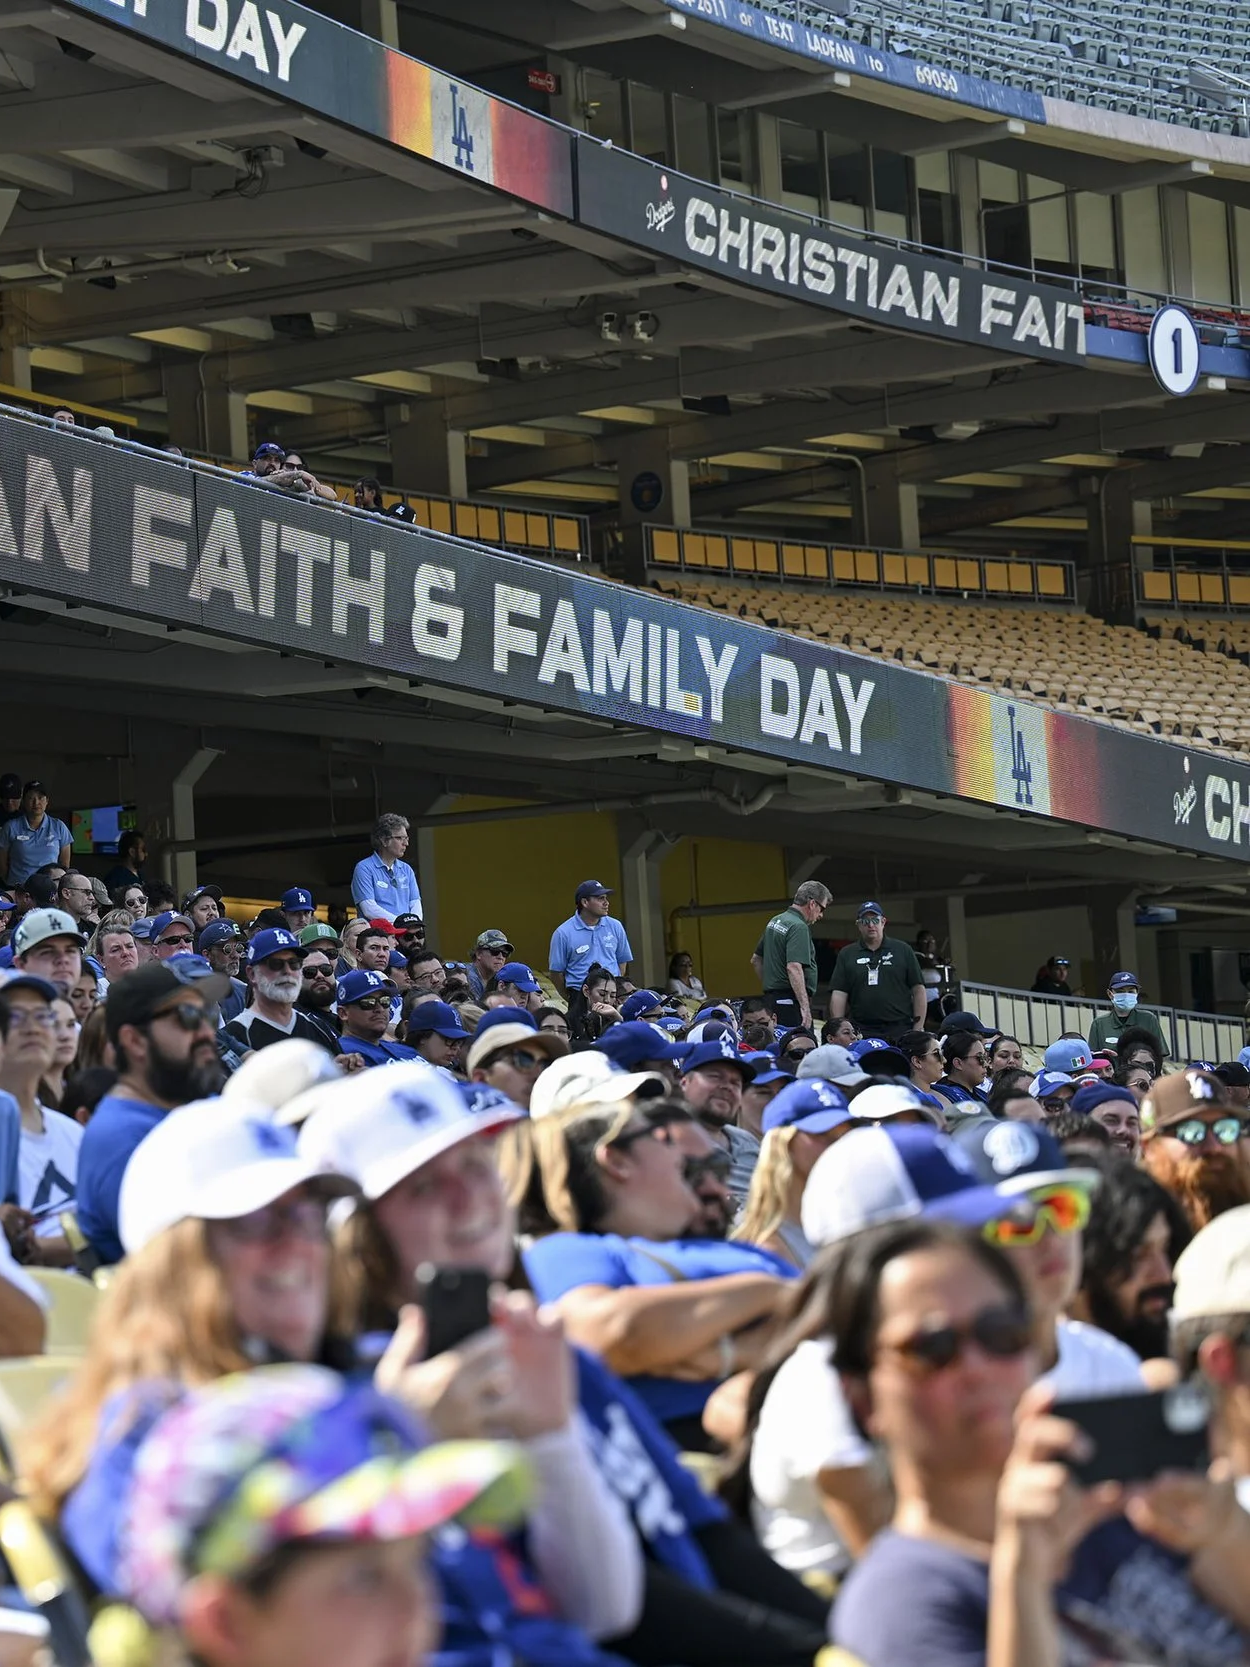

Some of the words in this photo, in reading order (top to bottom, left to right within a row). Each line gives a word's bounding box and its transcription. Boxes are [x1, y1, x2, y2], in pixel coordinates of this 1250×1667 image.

[185, 0, 307, 82] DAY
[765, 15, 795, 44] TEXT
[806, 31, 855, 65] LADFAN
[869, 56, 884, 73] to
[915, 64, 958, 94] 69050
[450, 84, 474, 171] LA
[685, 197, 960, 327] CHRISTIAN
[1171, 327, 1183, 374] 1
[131, 484, 386, 645] FAITH
[411, 564, 464, 661] &
[493, 582, 740, 722] FAMILY
[760, 654, 876, 755] DAY
[1006, 705, 1034, 804] LA
[49, 914, 62, 931] LA
[299, 891, 307, 903] LA
[273, 928, 289, 945] LA
[364, 971, 380, 986] LA
[868, 1039, 883, 1049] LA
